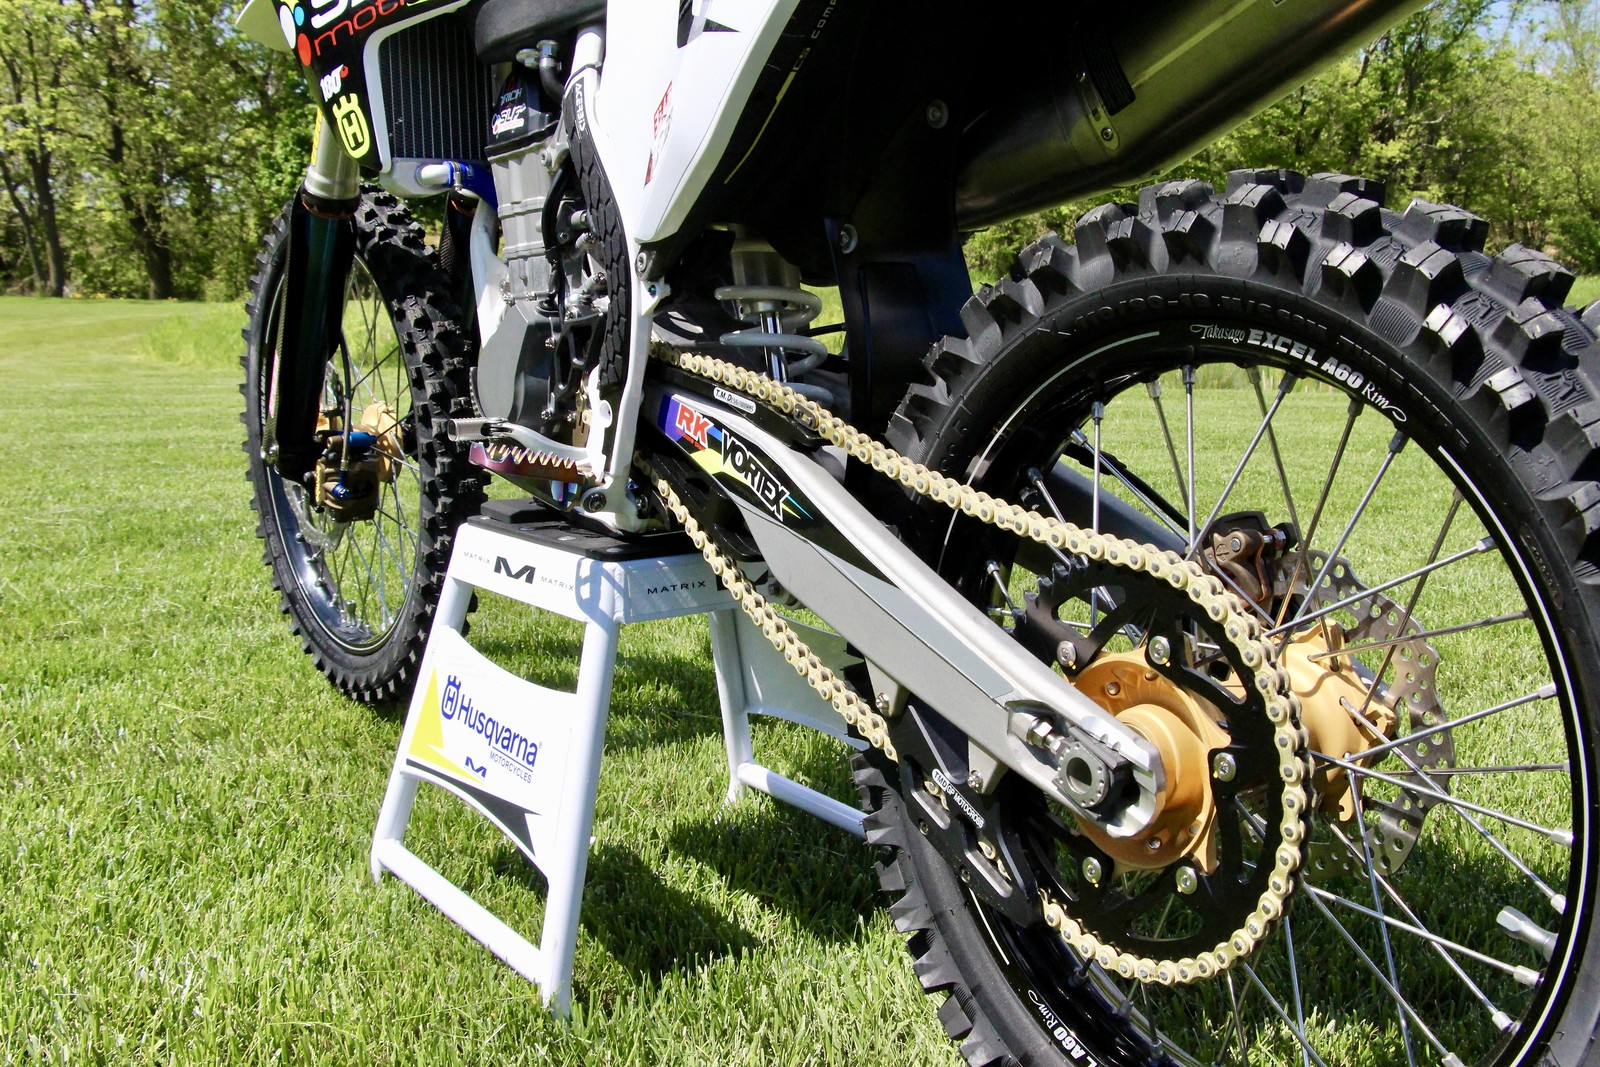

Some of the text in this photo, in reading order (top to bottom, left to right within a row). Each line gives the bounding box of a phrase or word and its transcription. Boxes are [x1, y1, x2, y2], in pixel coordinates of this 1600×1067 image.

[1190, 324, 1407, 422] Takasago EXCEL A60 Rim
[676, 403, 714, 448] RK
[722, 429, 790, 522] VORTEX
[463, 551, 491, 565] MATRIX
[540, 575, 574, 592] MATRIX
[646, 580, 707, 596] MATRIX
[457, 694, 538, 767] Husqvarna
[489, 751, 533, 784] MOTORCYCLES
[1028, 989, 1059, 1030] Rim
[1053, 1026, 1086, 1060] A60
